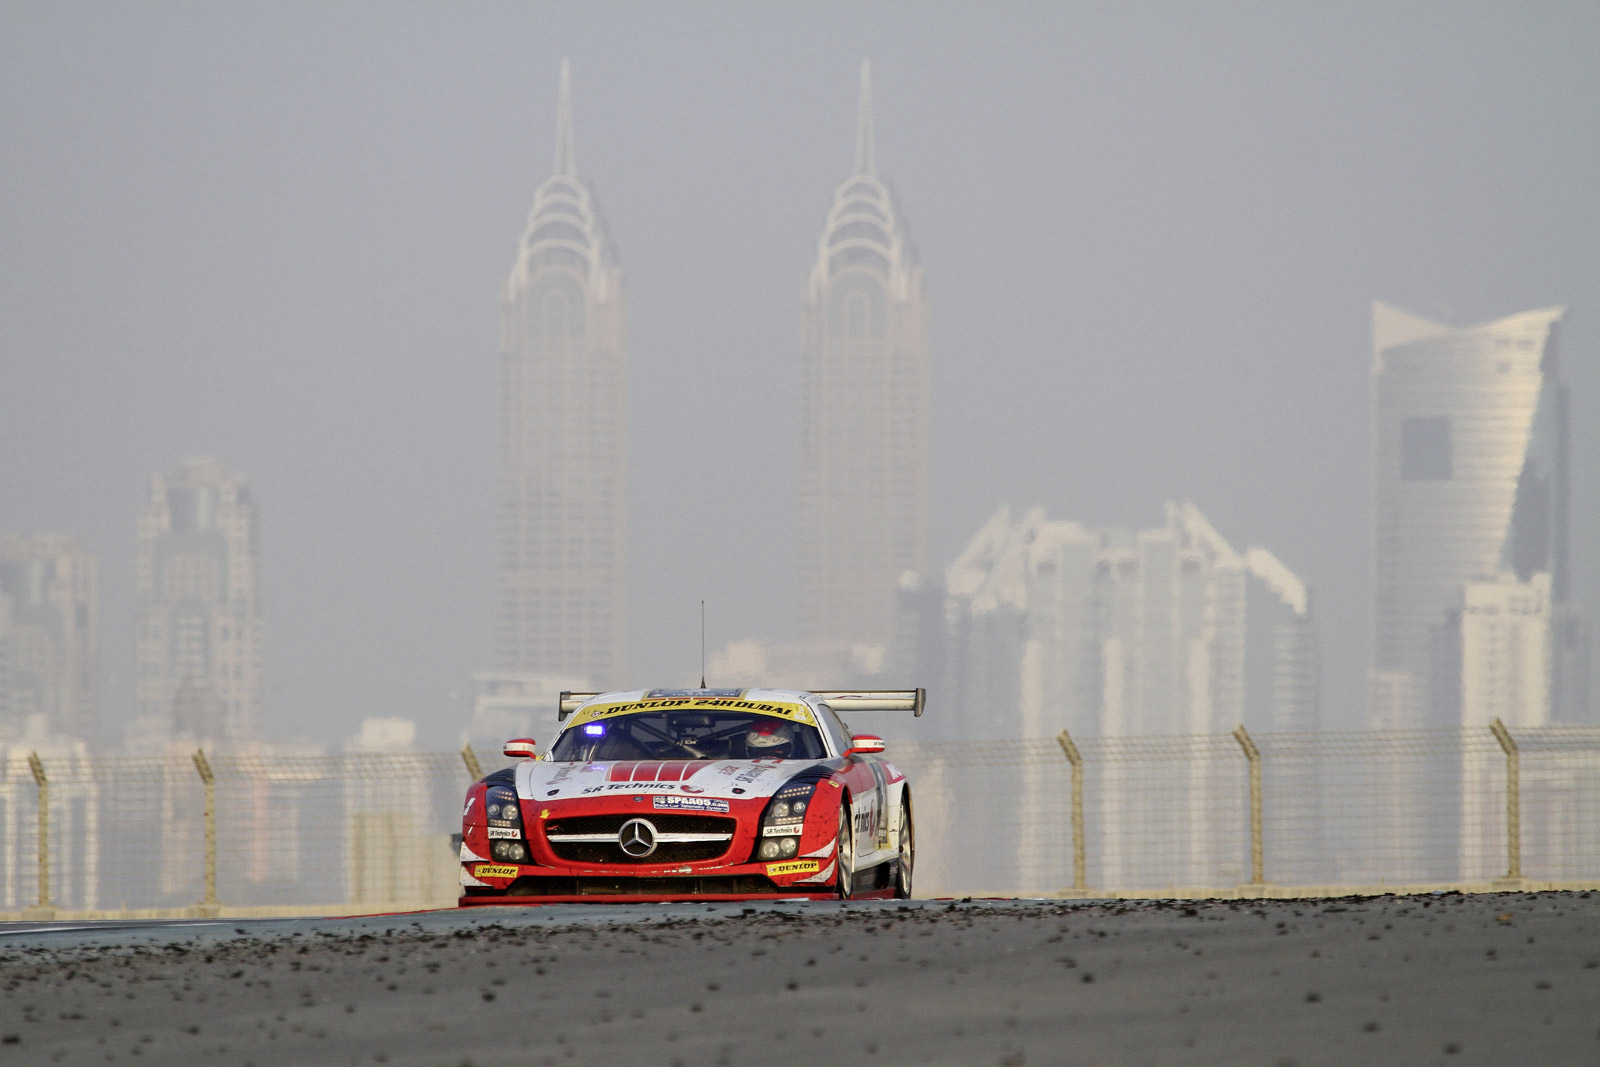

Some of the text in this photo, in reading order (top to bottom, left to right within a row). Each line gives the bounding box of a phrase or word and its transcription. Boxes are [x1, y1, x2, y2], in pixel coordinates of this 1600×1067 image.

[605, 700, 691, 715] DUNLOP
[734, 701, 792, 715] DUBAI
[581, 782, 676, 795] SR Technics
[481, 867, 516, 875] DUNLOP
[778, 862, 817, 872] DUNLOP
